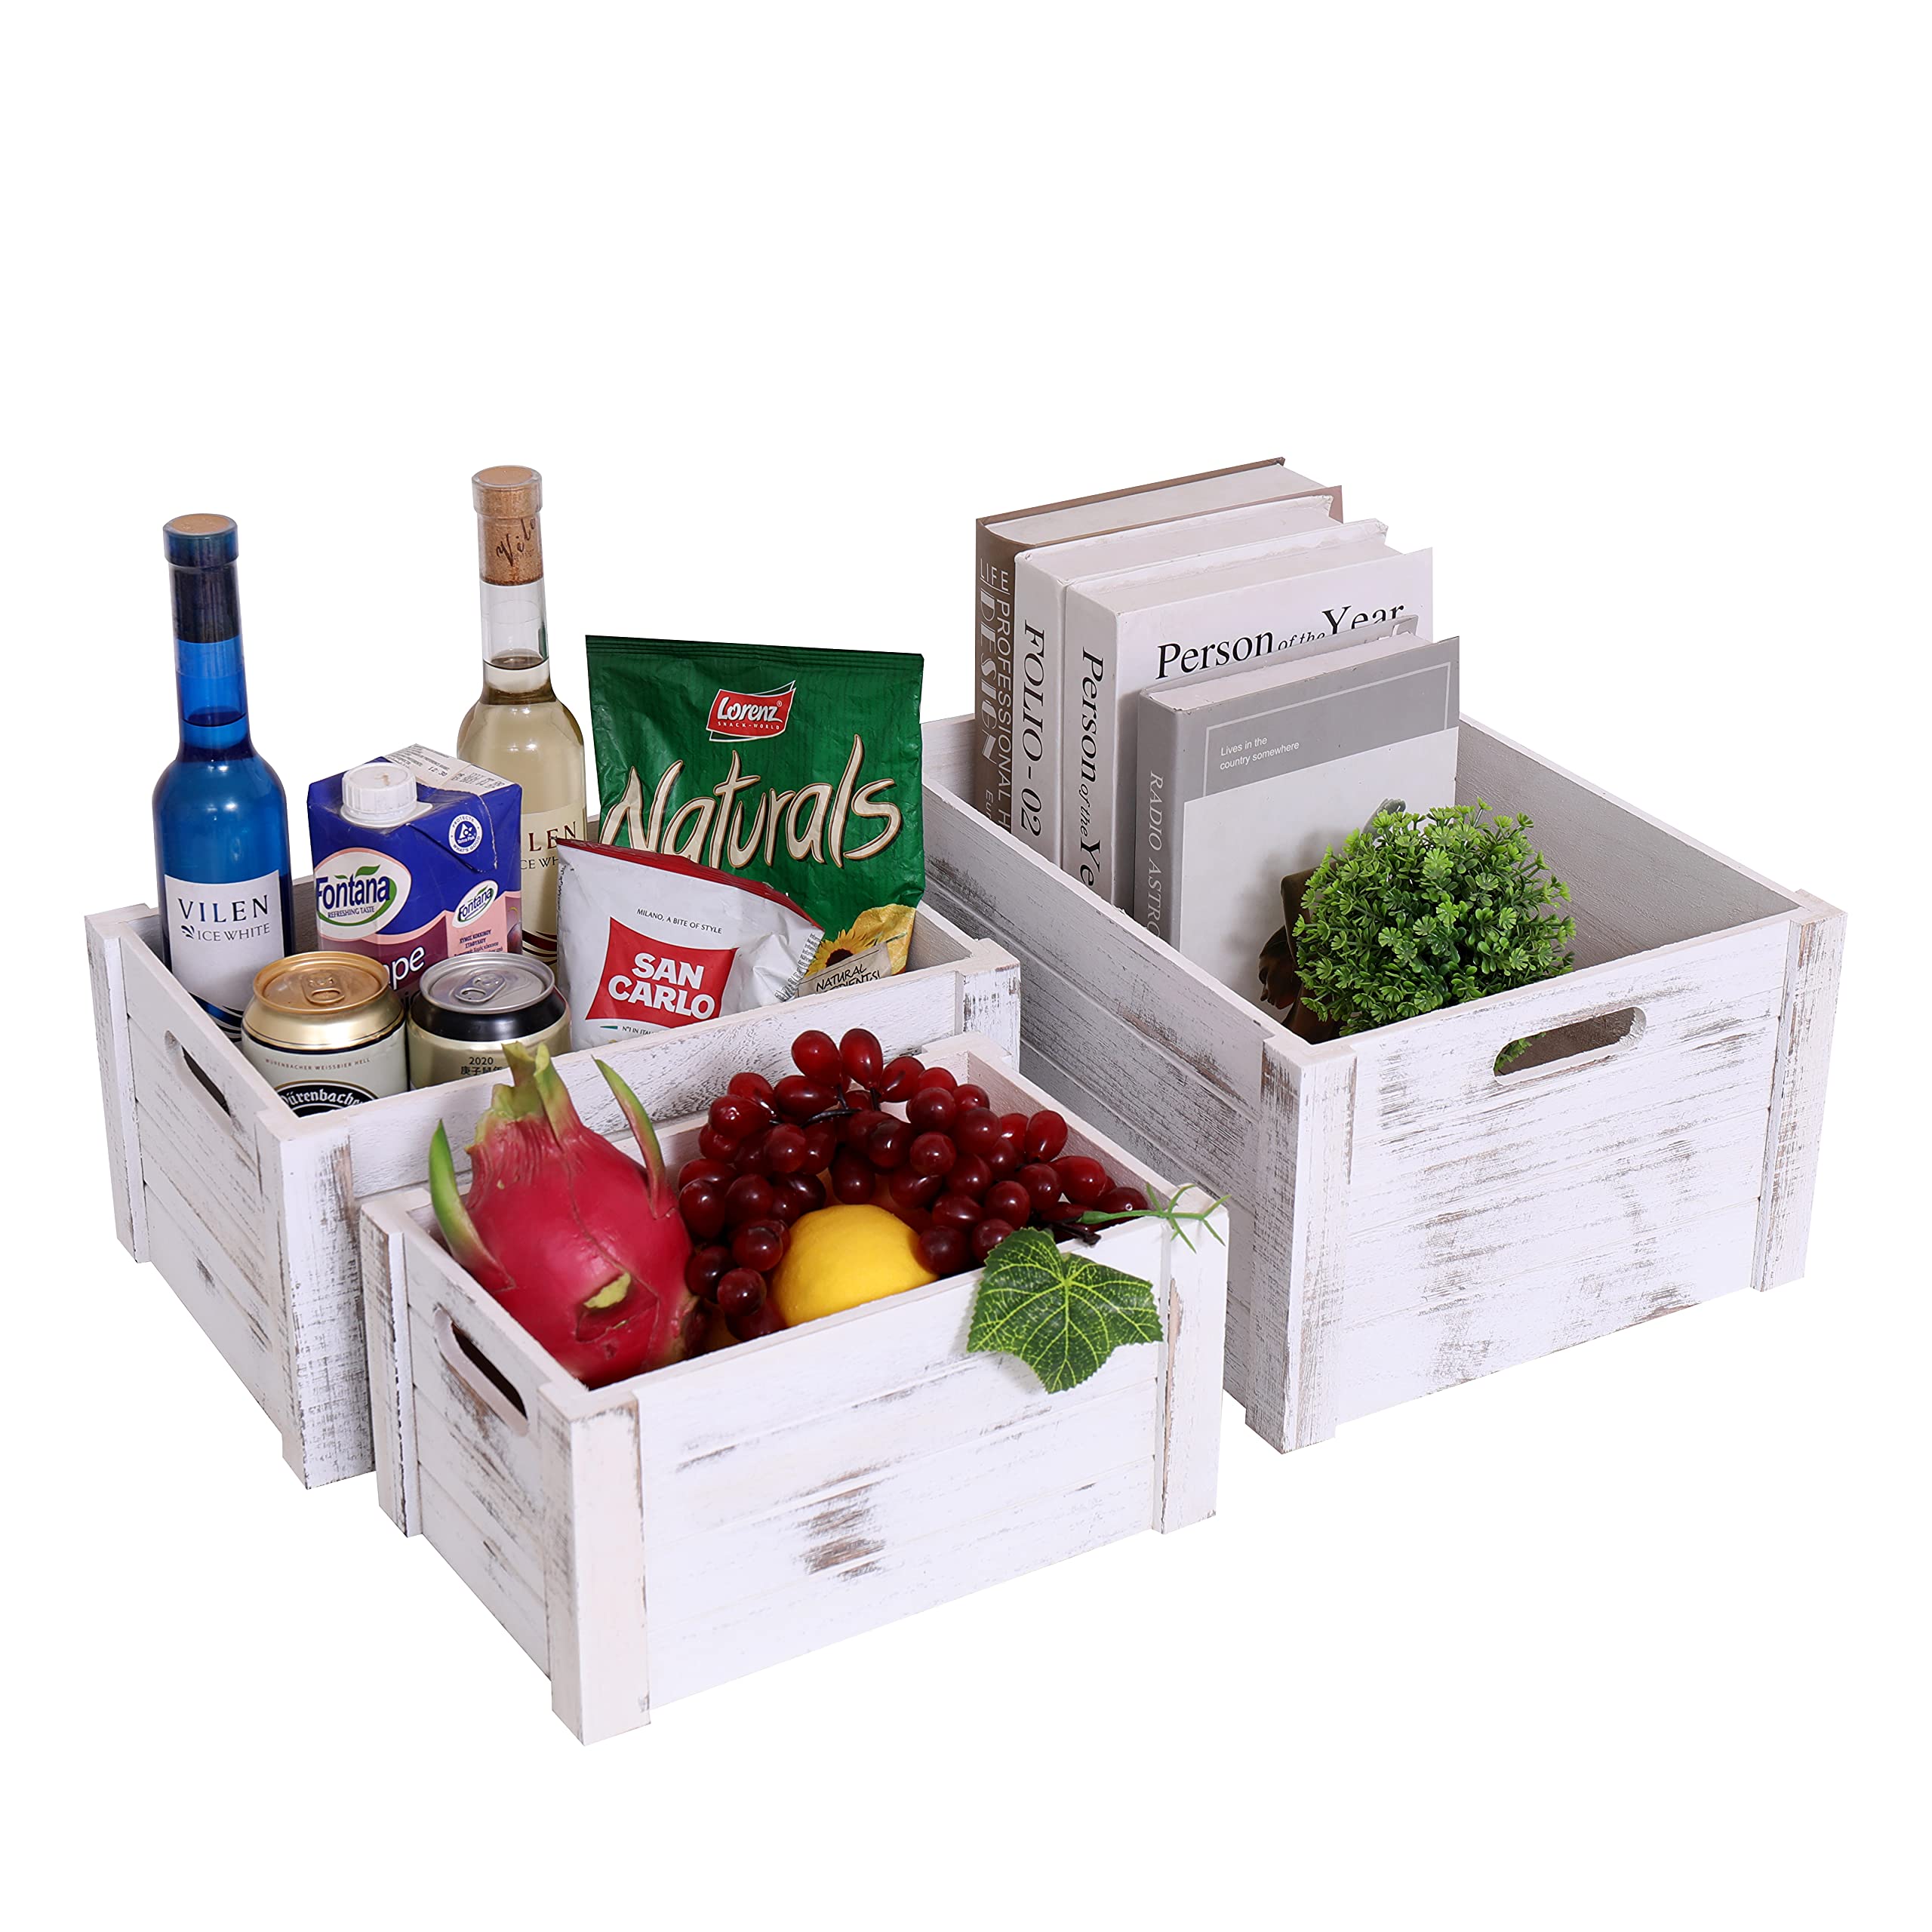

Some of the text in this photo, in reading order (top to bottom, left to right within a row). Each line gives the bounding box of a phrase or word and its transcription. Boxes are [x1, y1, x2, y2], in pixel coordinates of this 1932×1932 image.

[980, 558, 1009, 592] LIFE
[1155, 605, 1404, 680] Person of the Year
[980, 588, 997, 764] DESIGN
[1022, 619, 1045, 762] FOLIO
[717, 696, 783, 724] Lorenz
[996, 598, 1012, 801] PROFESSIONAL
[1081, 646, 1104, 783] Person
[718, 721, 780, 731] SNACK-WORLD
[1220, 737, 1268, 757] Lives in the
[1220, 742, 1300, 771] country somewhere
[599, 734, 902, 870] Naturals
[1020, 788, 1043, 837] 02
[1078, 783, 1091, 811] of
[1080, 804, 1091, 838] the
[1146, 770, 1164, 938] RADIO ASTRO
[315, 873, 390, 909] Fontana
[458, 888, 493, 921] Fontana
[177, 894, 269, 923] VILEN
[328, 906, 375, 918] REFRESHING TASTE
[636, 908, 665, 921] MILANO,
[672, 918, 688, 927] BITE
[701, 924, 723, 935] STYLE
[198, 923, 270, 942] ICE WHITE
[632, 952, 706, 990] SAN
[816, 963, 867, 992] NATURAL
[608, 974, 716, 1020] CARLO
[354, 1057, 371, 1066] HELL
[469, 1057, 494, 1066] 2020
